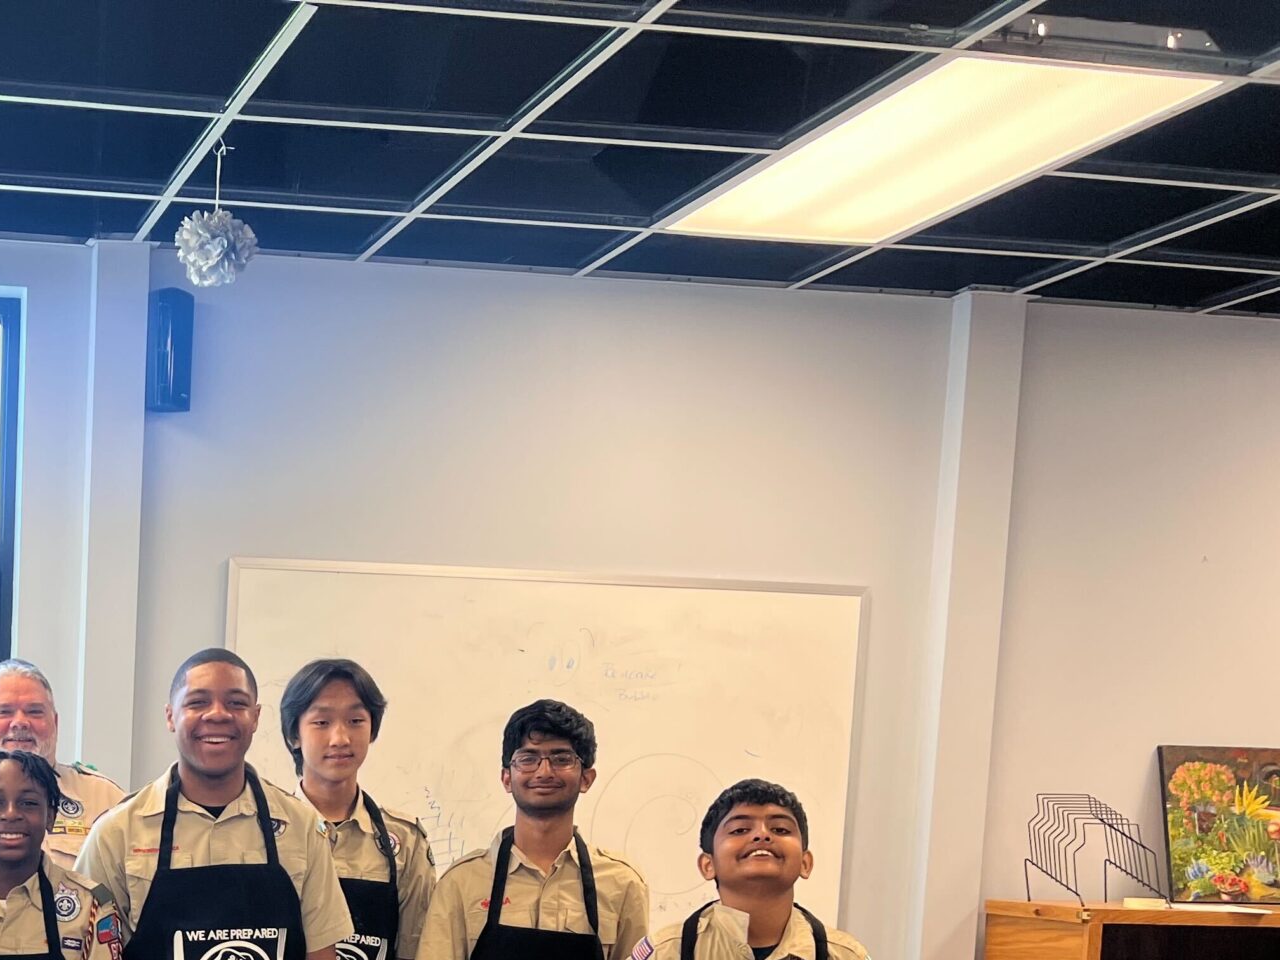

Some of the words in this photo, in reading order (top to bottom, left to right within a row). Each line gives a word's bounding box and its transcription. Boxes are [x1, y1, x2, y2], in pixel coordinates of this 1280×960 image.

[185, 930, 206, 942] WE
[207, 928, 230, 941] ARE
[230, 927, 278, 940] PREPARED
[344, 933, 381, 947] REPARED
